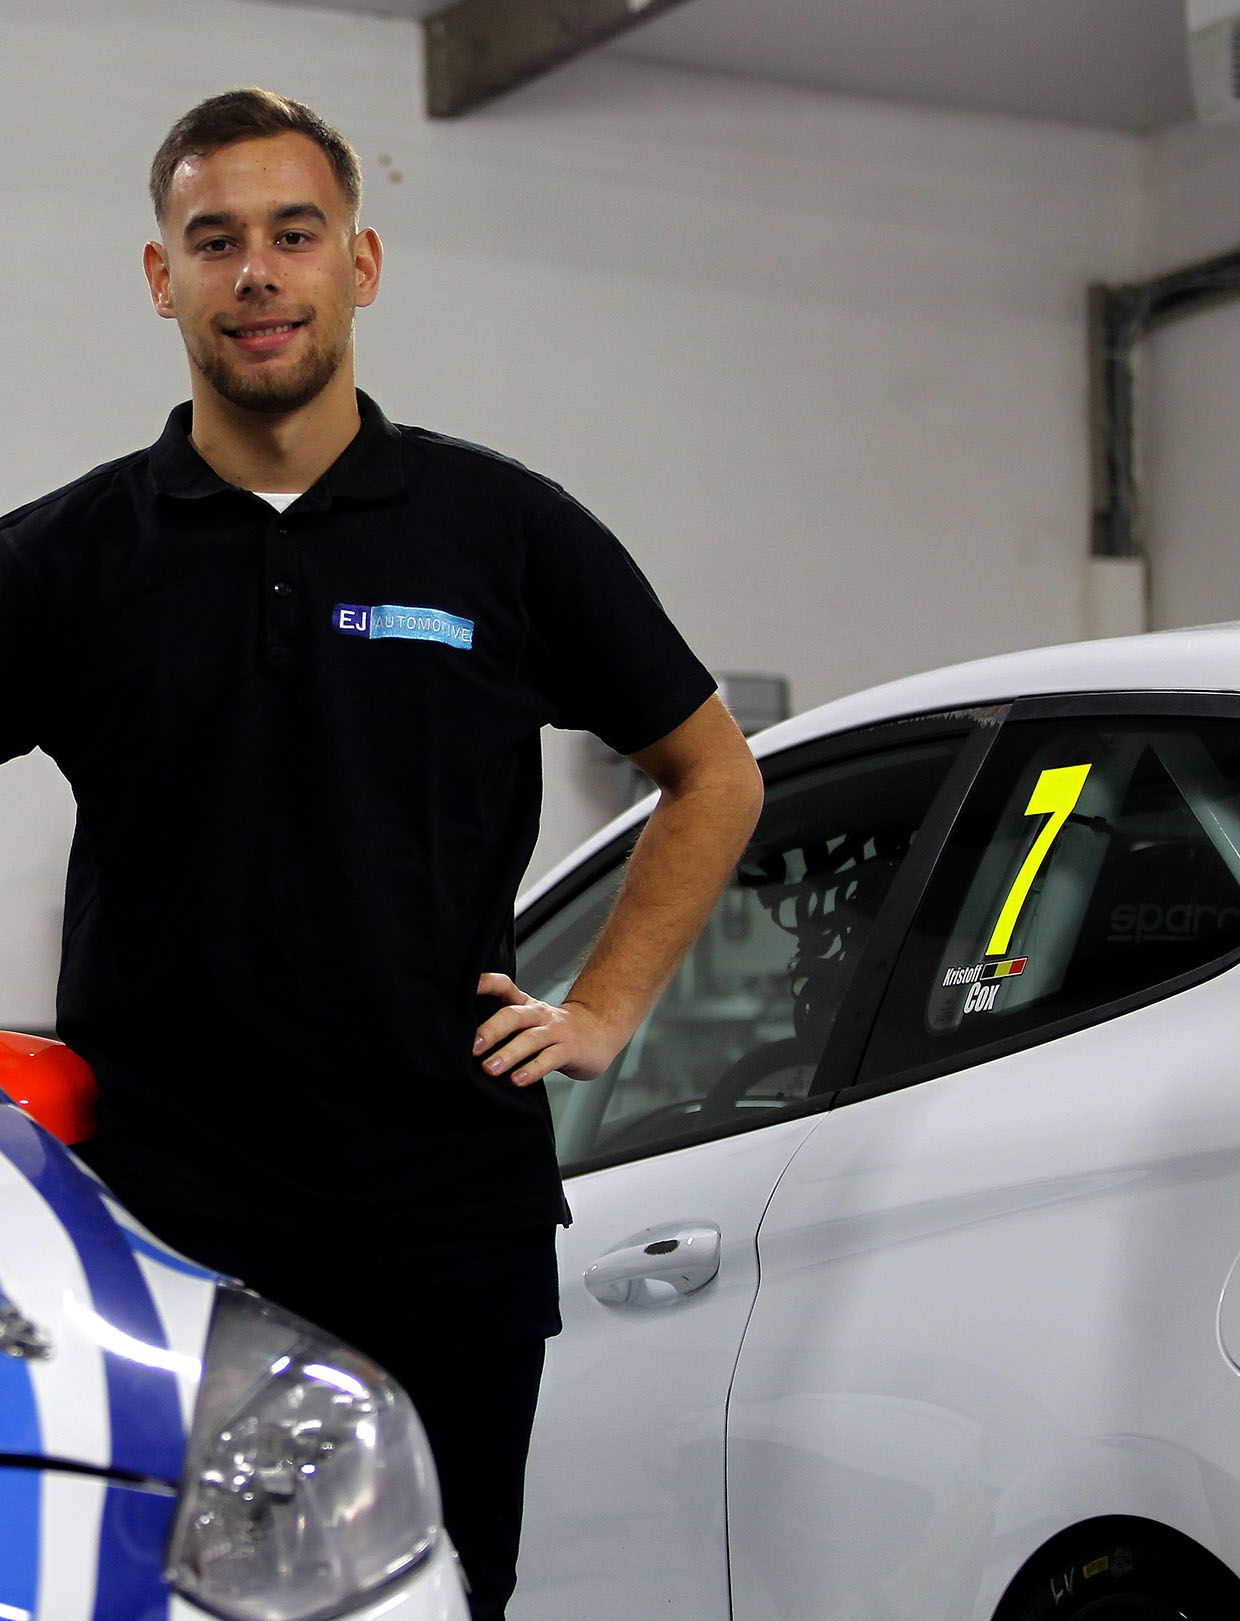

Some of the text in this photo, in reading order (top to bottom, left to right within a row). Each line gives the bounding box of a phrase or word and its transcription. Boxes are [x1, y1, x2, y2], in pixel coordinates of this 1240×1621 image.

[339, 609, 471, 642] EJ AUTOMOTIVE
[985, 763, 1093, 956] 7
[942, 963, 984, 987] Kristoff
[963, 981, 1001, 1014] Cox
